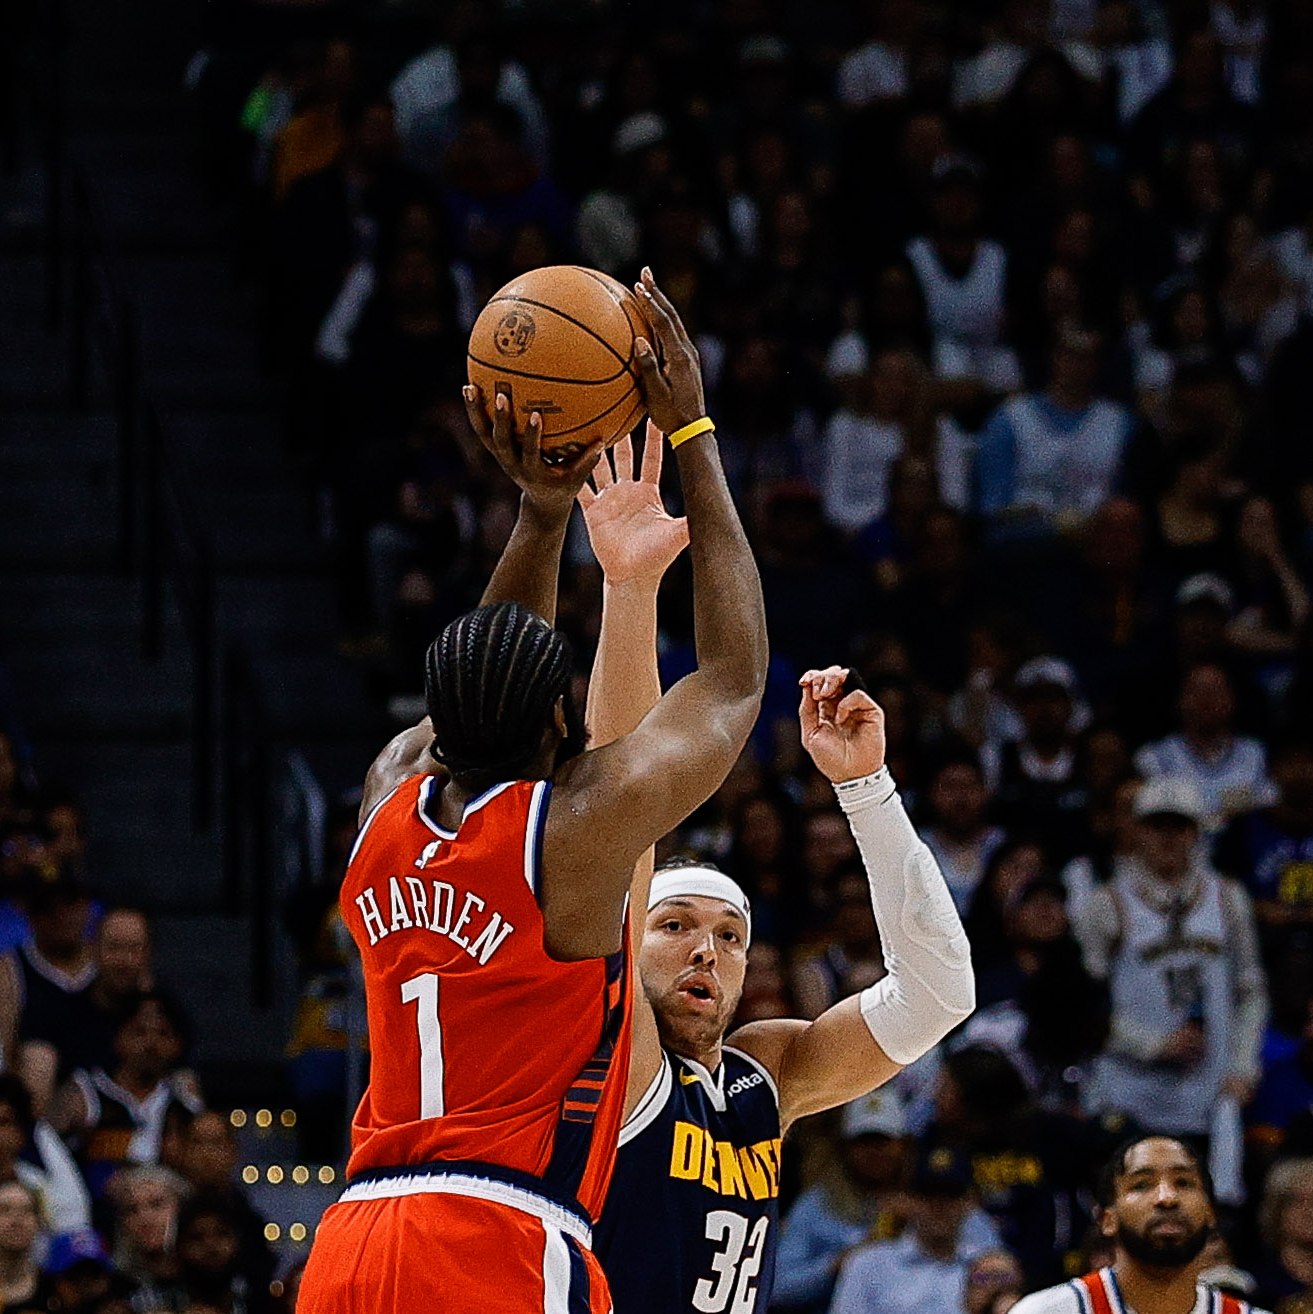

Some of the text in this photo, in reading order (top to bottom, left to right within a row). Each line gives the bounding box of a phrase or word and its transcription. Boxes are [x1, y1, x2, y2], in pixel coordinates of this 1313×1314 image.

[355, 876, 514, 966] HARDEN
[400, 972, 445, 1121] 1
[726, 1071, 765, 1099] otta
[669, 1120, 783, 1202] DENVE
